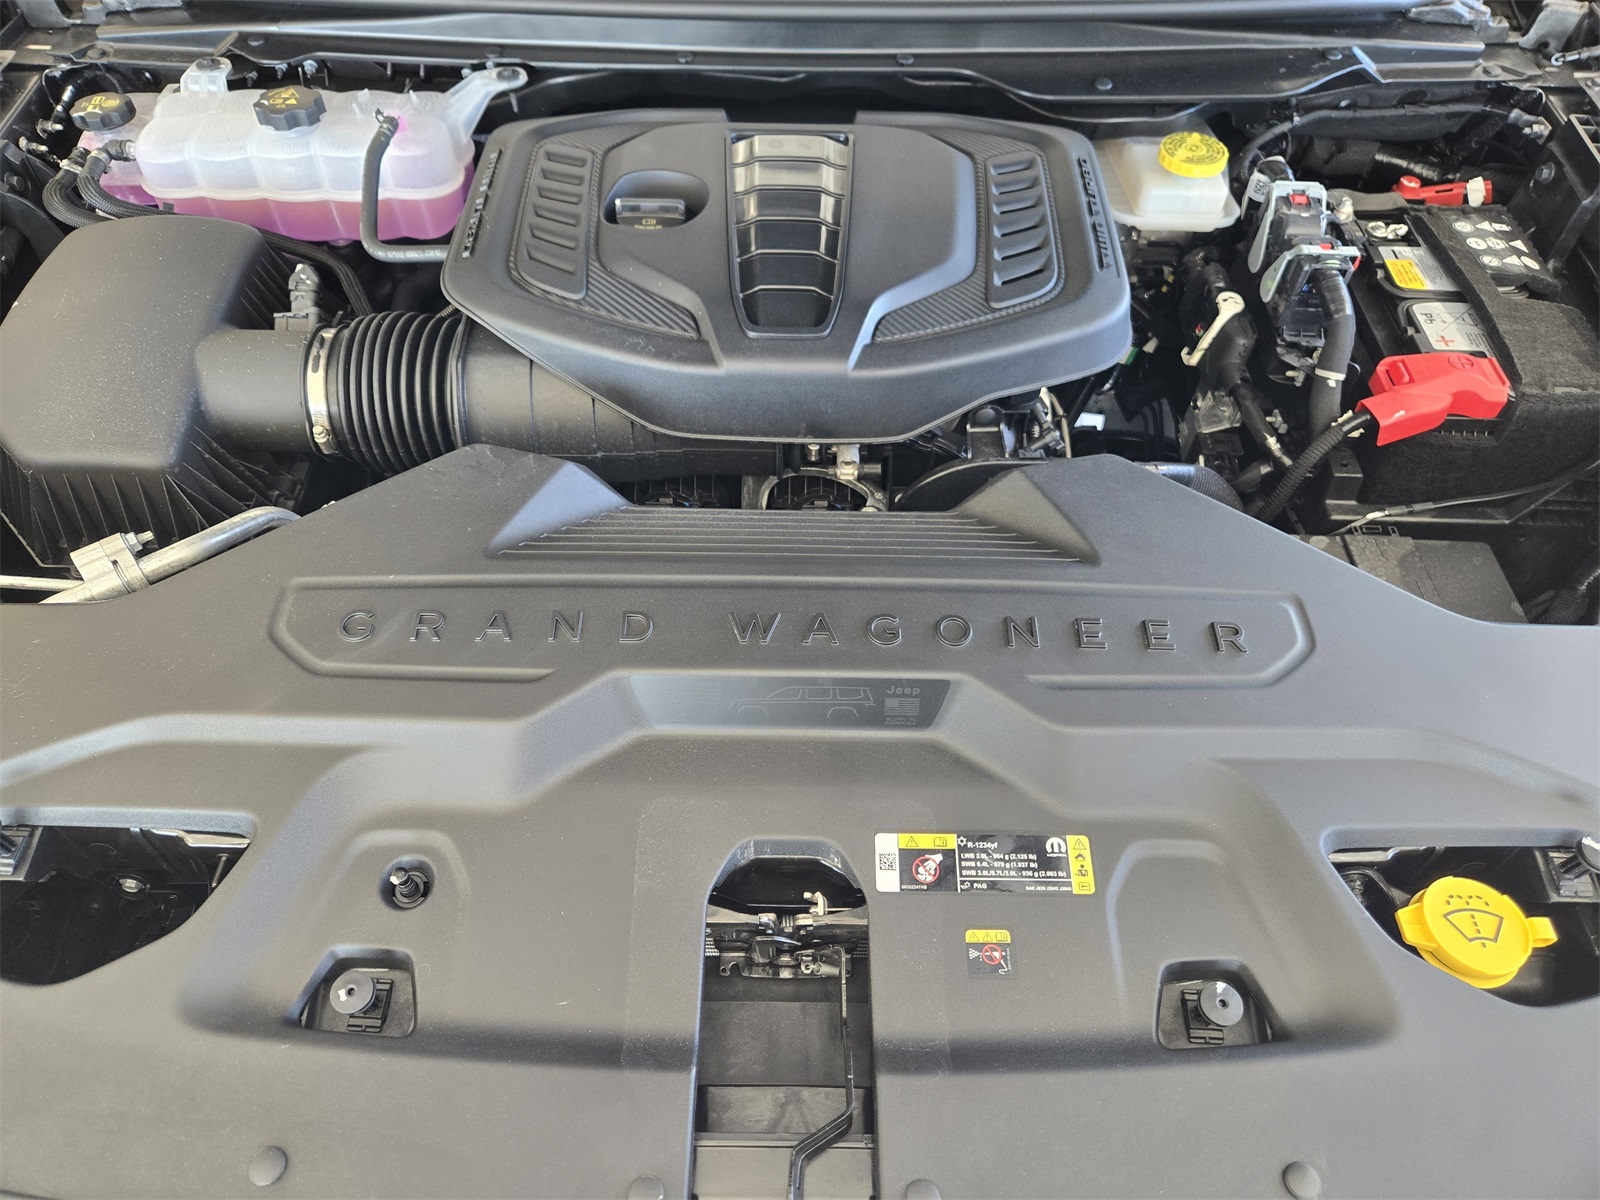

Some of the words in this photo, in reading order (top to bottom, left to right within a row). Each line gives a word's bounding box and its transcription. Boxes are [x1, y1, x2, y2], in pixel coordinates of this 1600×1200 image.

[1077, 157, 1101, 217] TURBO
[1091, 220, 1112, 271] TWIN
[338, 609, 654, 643] GRAND
[729, 611, 1248, 654] WAGONEER
[886, 685, 920, 697] Jeep
[967, 841, 998, 850] R-1234yf
